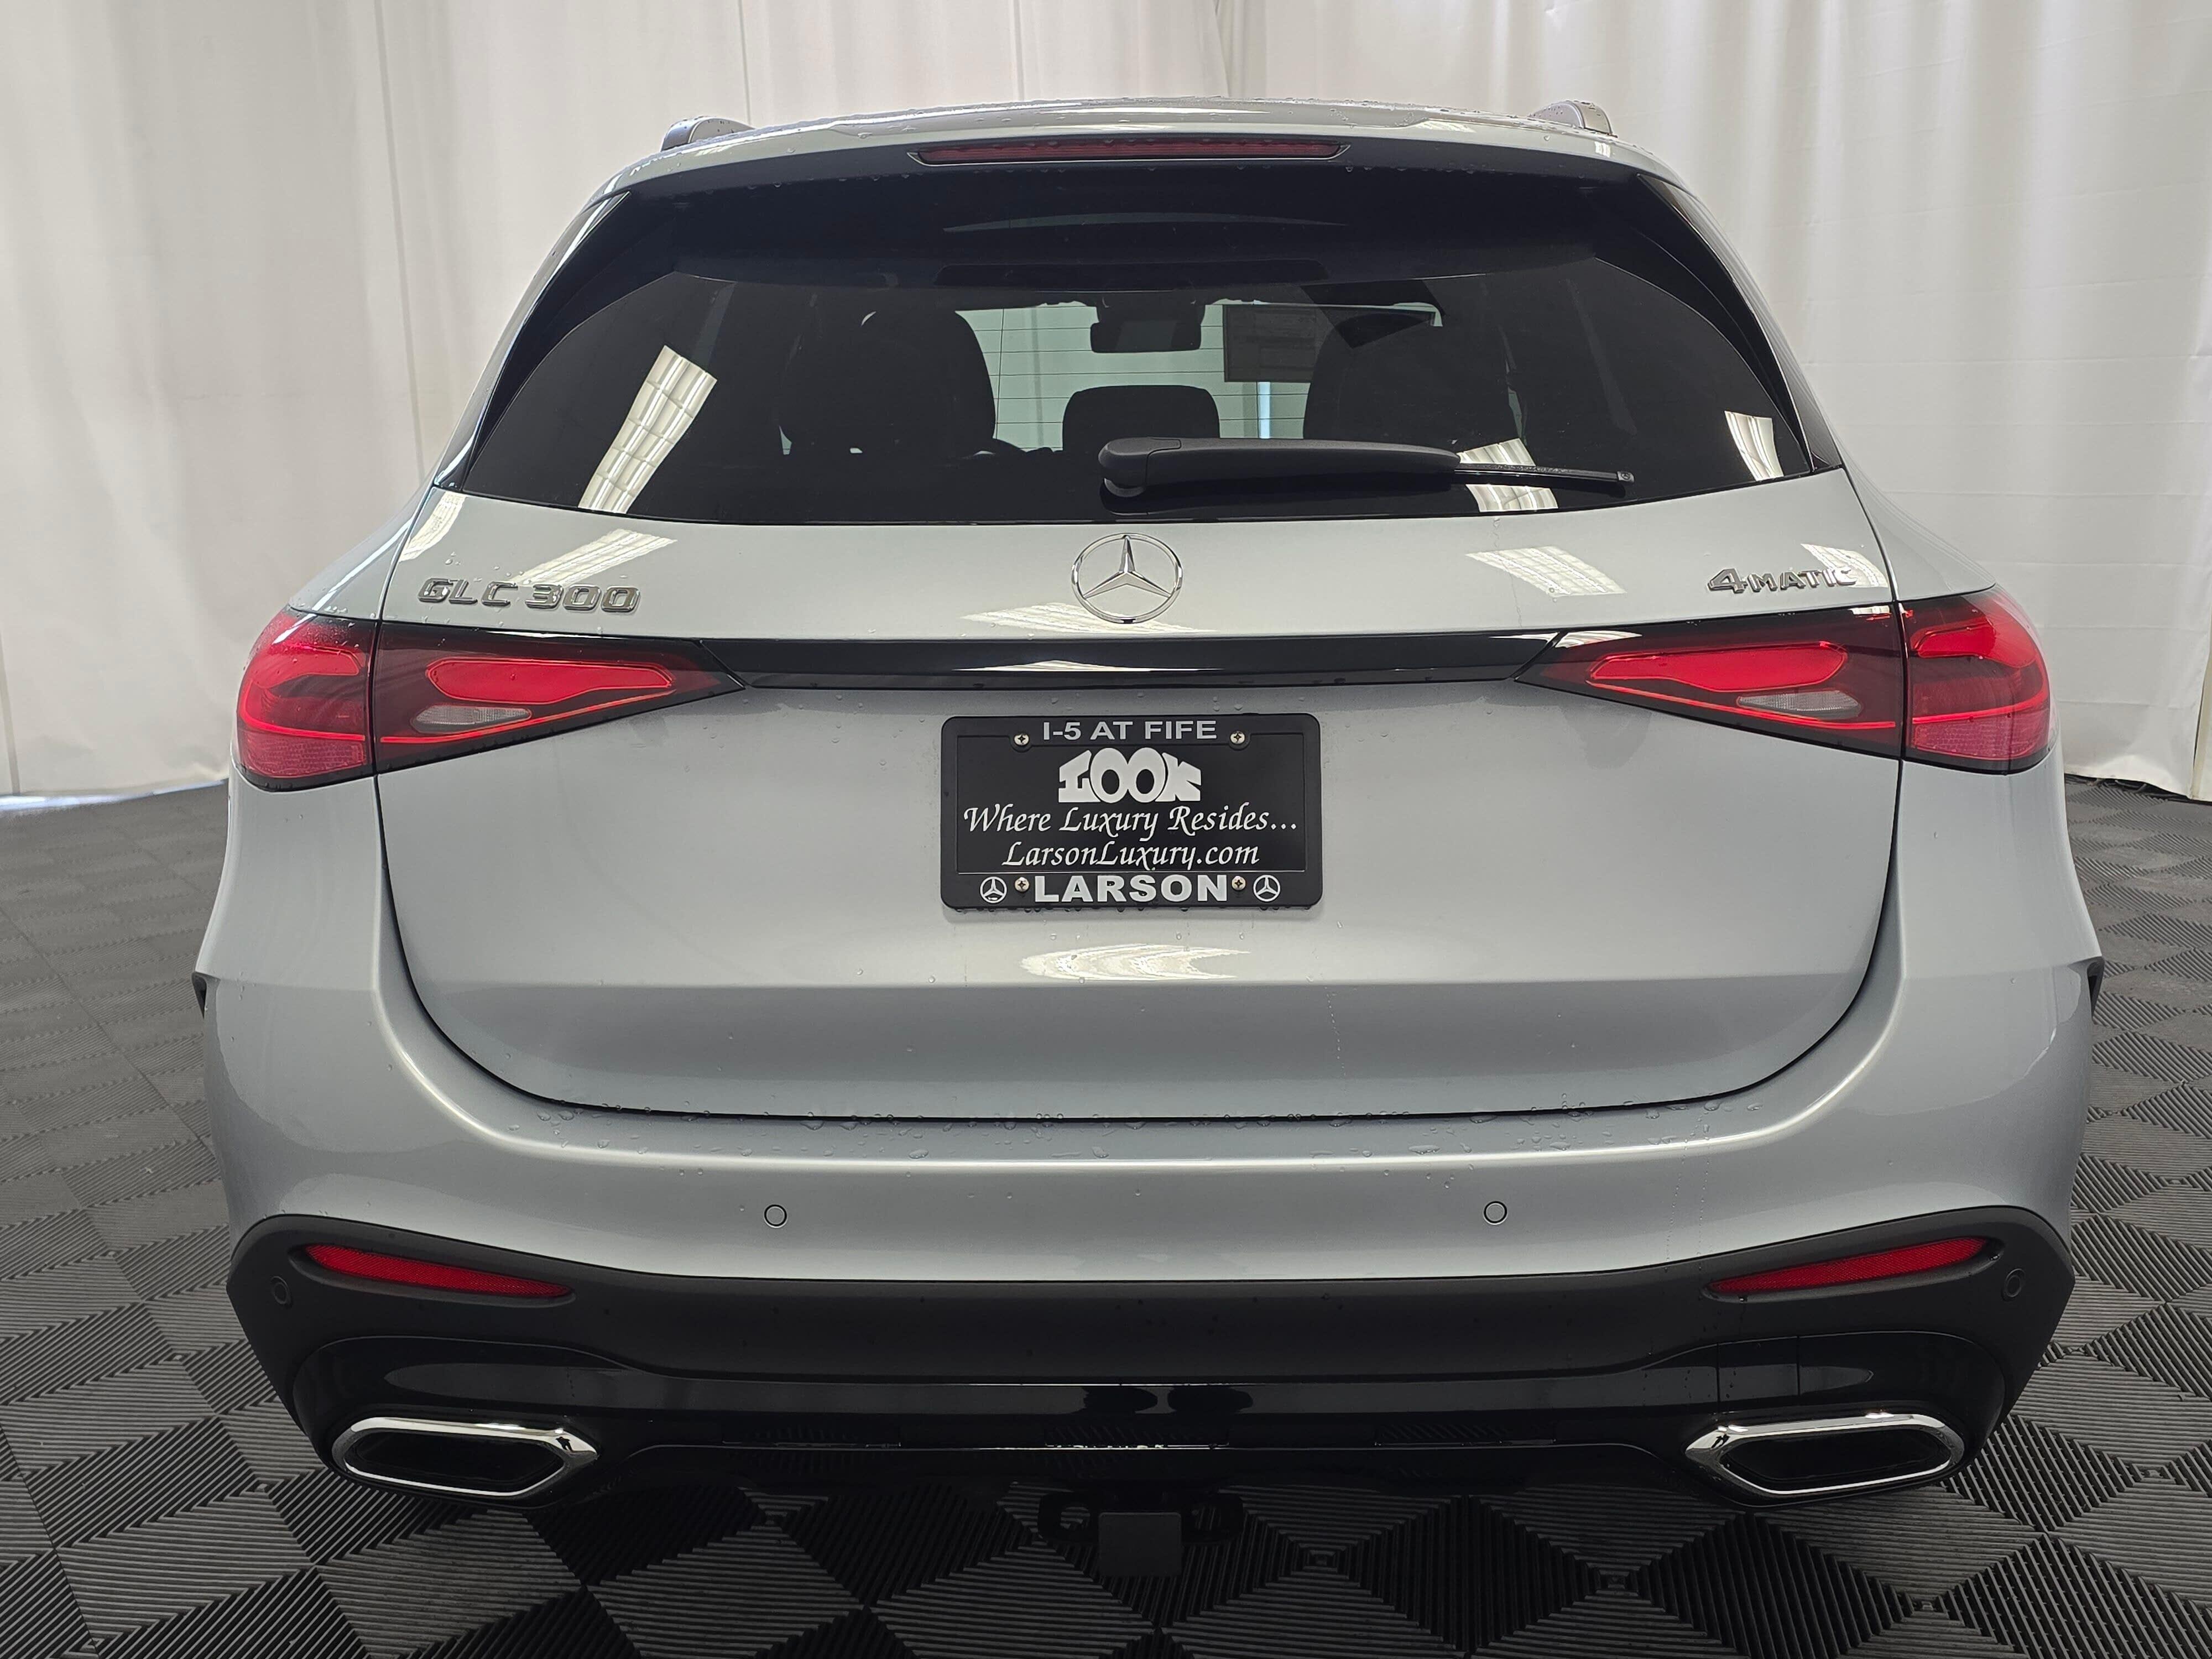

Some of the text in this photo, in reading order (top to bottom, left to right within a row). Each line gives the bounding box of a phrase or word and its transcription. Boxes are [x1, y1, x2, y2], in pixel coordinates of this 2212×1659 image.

[417, 577, 641, 613] GLC 300
[1708, 567, 1858, 593] 4MATIC
[1043, 720, 1217, 740] I-5 AT FIFE
[1057, 747, 1202, 804] LOOK
[963, 801, 1297, 842] Where Luxury Resides...
[1001, 840, 1260, 871] LarsonLuxury.com
[1034, 874, 1228, 902] LARSON
